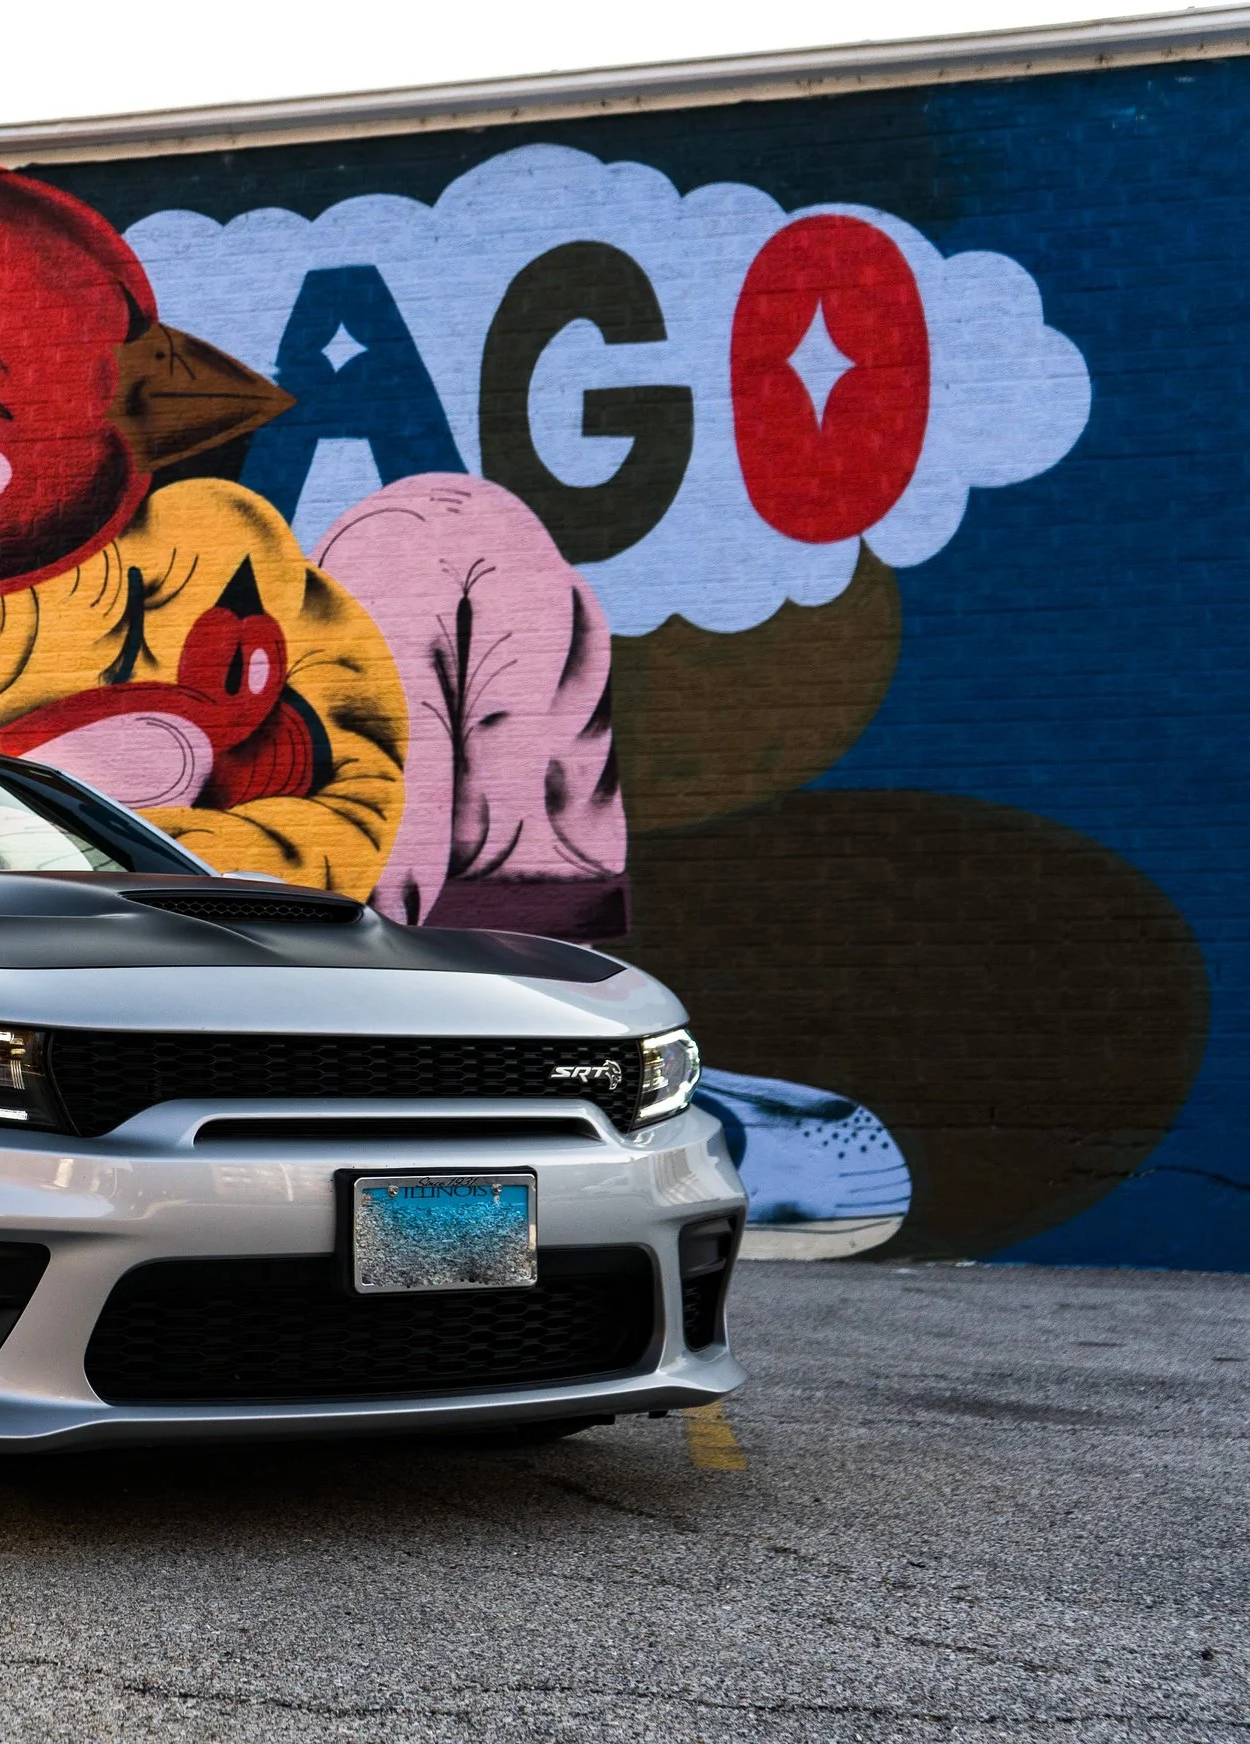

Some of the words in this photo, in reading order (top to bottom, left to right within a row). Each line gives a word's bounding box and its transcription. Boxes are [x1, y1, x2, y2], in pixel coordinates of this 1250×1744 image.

[551, 1066, 609, 1083] SRT
[417, 1176, 445, 1187] Since
[403, 1185, 488, 1199] ILLINOIS
